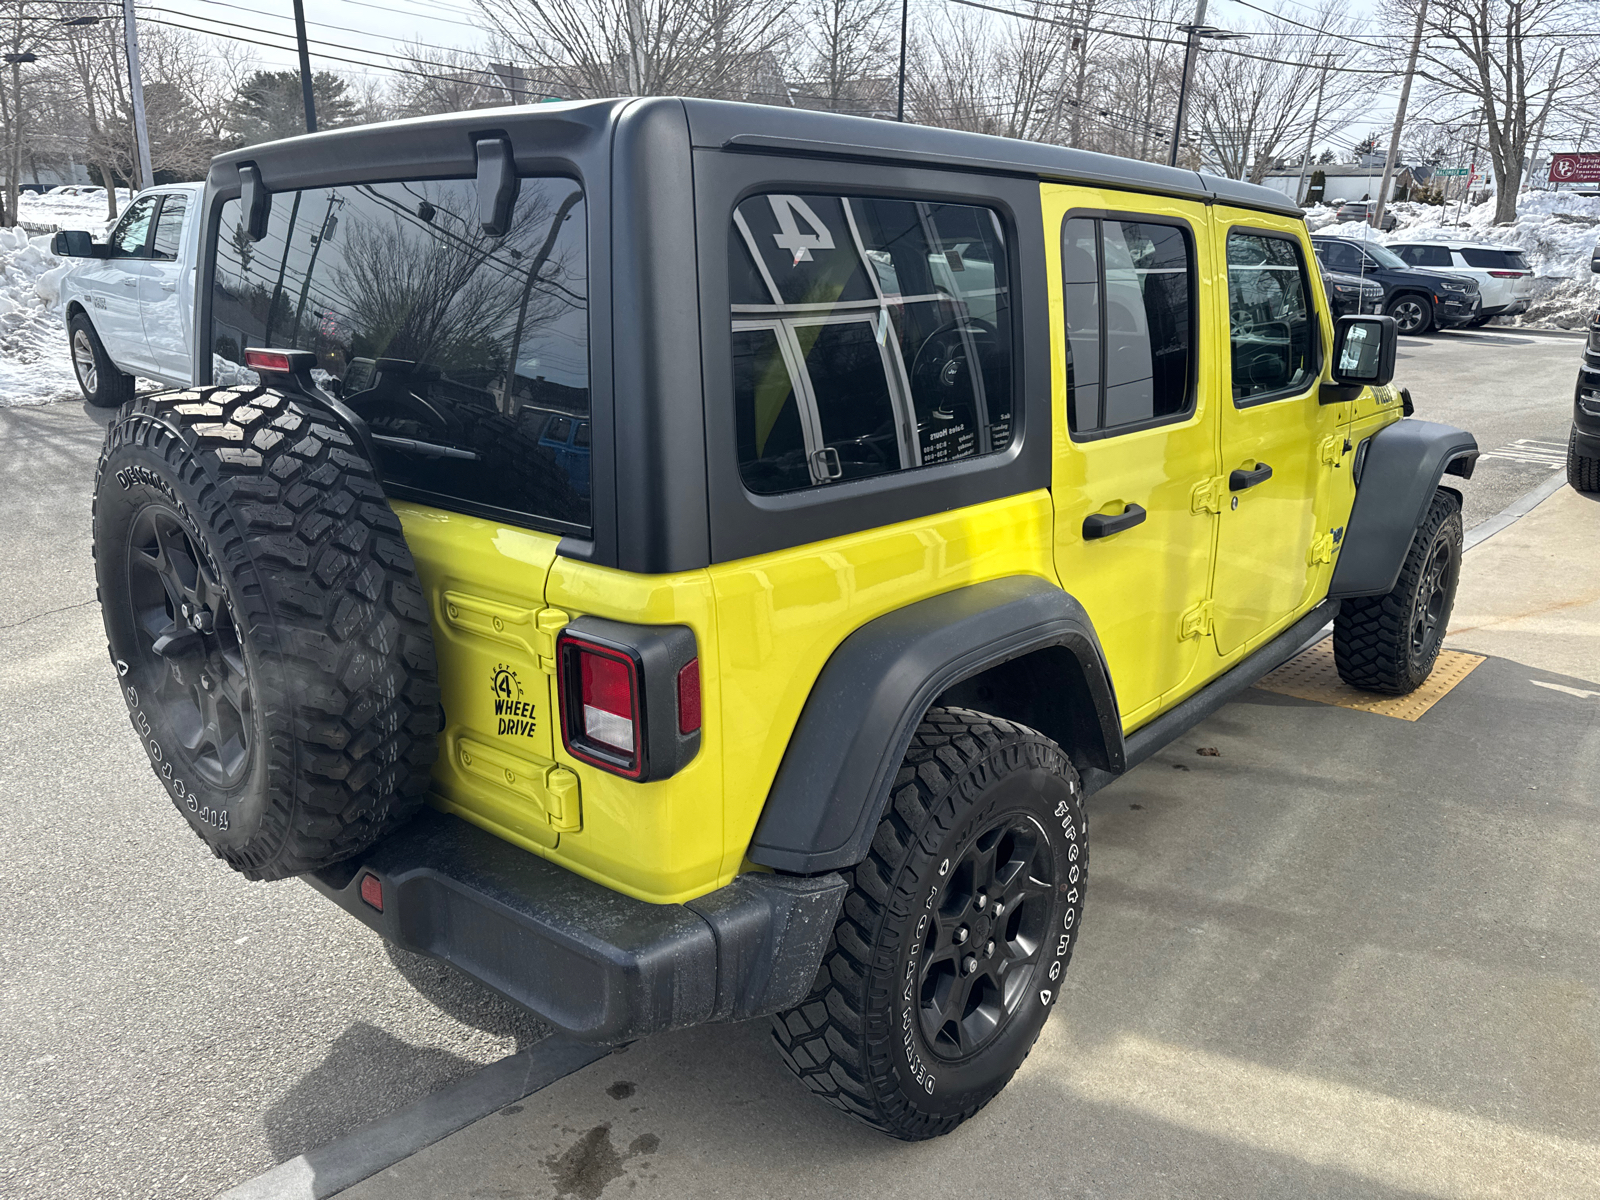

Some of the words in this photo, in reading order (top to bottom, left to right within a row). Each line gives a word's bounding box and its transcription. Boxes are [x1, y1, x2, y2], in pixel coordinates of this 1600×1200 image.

[490, 663, 524, 695] ELECTRIC
[498, 675, 512, 698] 4
[495, 699, 536, 719] WHEEL
[498, 718, 536, 737] DRIVE
[900, 885, 939, 1096] DESTINATION
